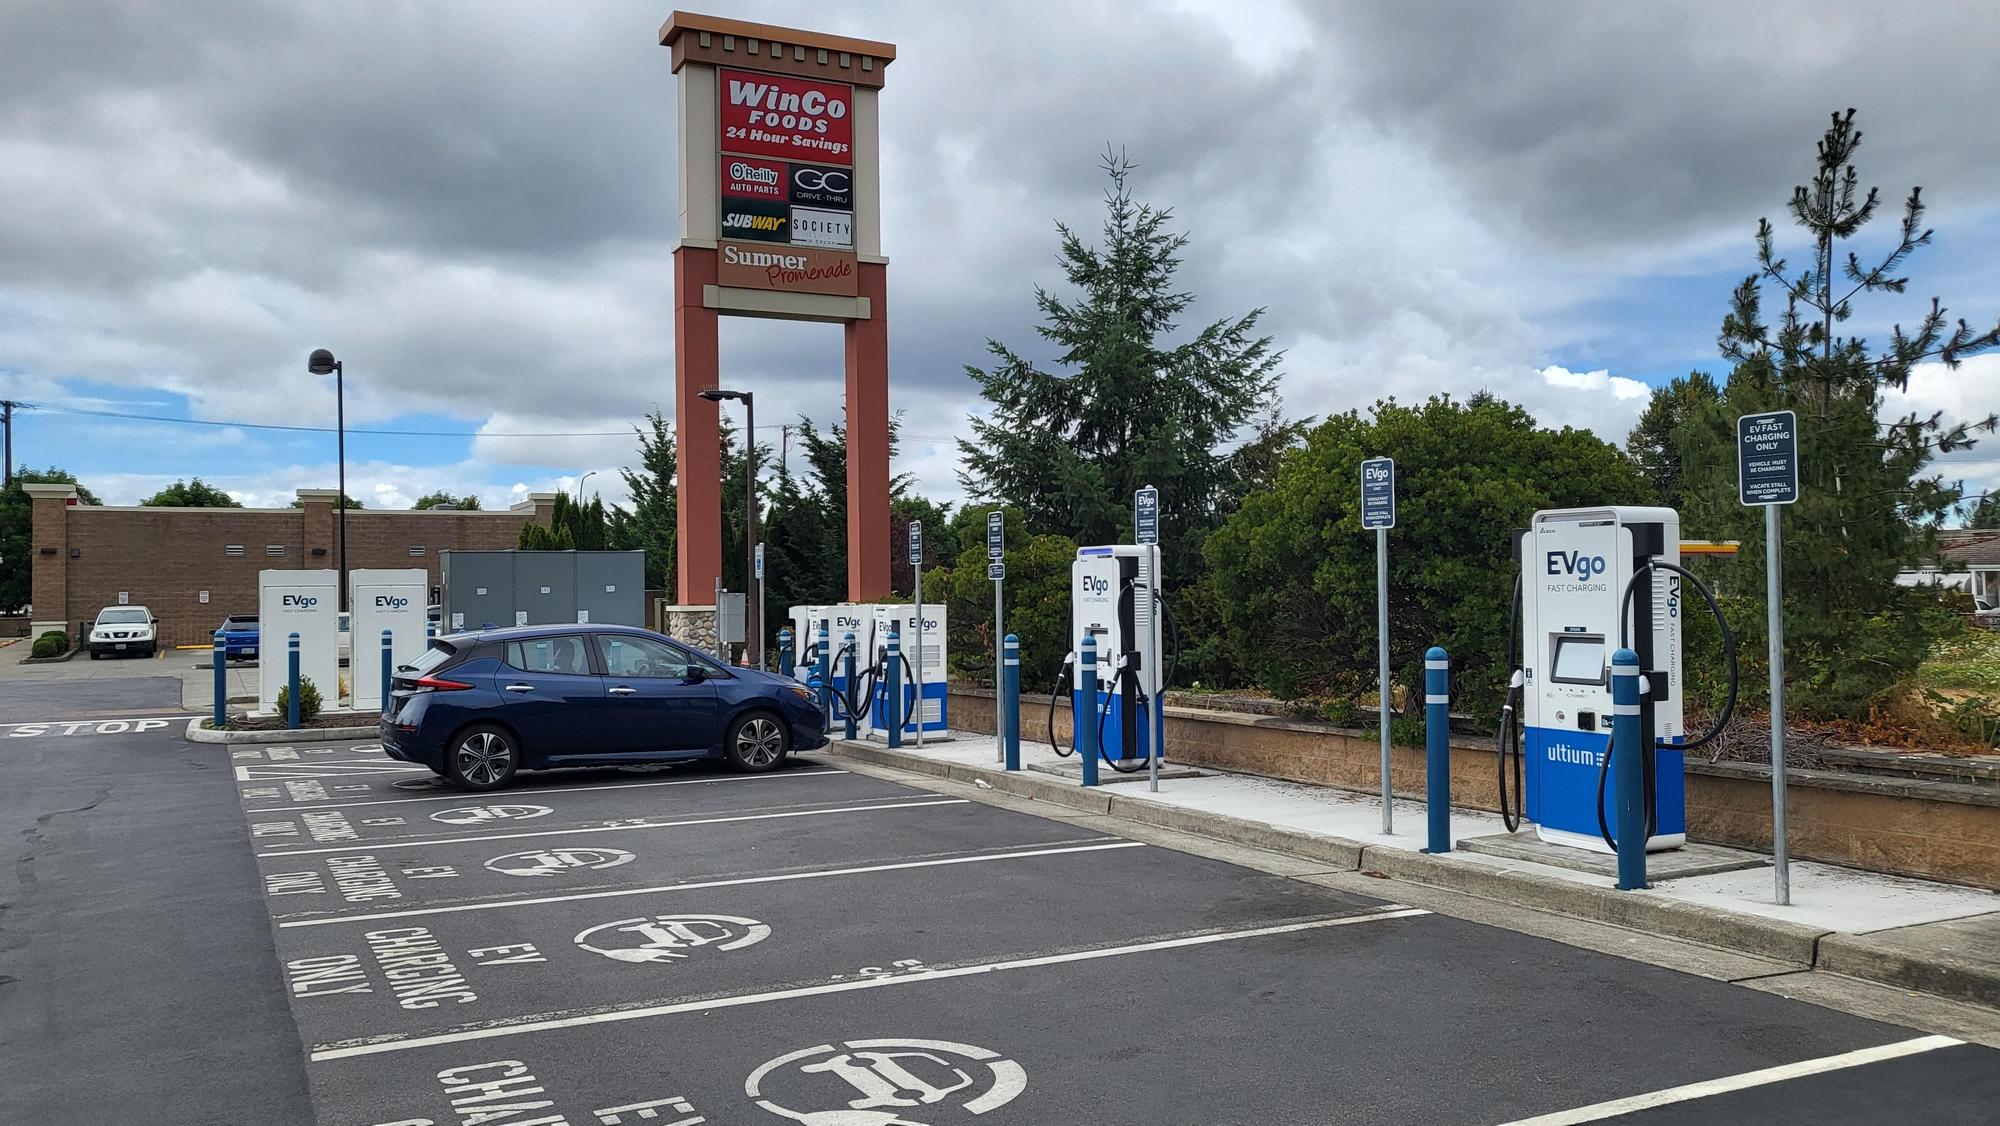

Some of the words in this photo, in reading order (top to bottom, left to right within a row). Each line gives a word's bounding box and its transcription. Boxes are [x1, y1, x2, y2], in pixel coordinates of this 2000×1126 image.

[729, 80, 846, 118] WinCo
[749, 110, 829, 133] FOODS
[726, 126, 746, 139] 24
[749, 129, 789, 144] Hour
[792, 135, 848, 154] Savings
[730, 162, 778, 185] O'Reilly
[794, 168, 848, 193] GC
[730, 183, 752, 192] AUTO
[754, 186, 779, 195] PARTS
[796, 192, 848, 203] DRIVE-THRU
[722, 213, 786, 231] SUBWAY
[793, 219, 850, 235] SOCIETY
[724, 246, 808, 270] Sumner
[765, 259, 852, 286] Promenade
[1744, 431, 1790, 443] CHARGING
[1749, 425, 1761, 433] EV
[1762, 423, 1784, 432] FAST
[1756, 442, 1778, 451] ONLY
[1366, 467, 1389, 481] EVgo
[1757, 465, 1786, 473] CHARGING
[1139, 495, 1155, 507] EVgo
[1547, 550, 1606, 581] EVgo
[1083, 575, 1109, 596] EVgo
[1547, 584, 1566, 592] FAST
[1566, 583, 1607, 592] CHARGING
[282, 595, 318, 609] EVgo
[375, 596, 408, 609] EVgo
[1667, 575, 1679, 618] EVgo
[9, 720, 170, 738] STOP
[1547, 743, 1594, 766] ultium
[325, 855, 402, 902] CHARGING
[400, 865, 460, 879] EV
[264, 871, 327, 896] ONLY
[467, 942, 547, 966] EV
[286, 954, 373, 998] ONLY
[364, 926, 478, 1010] CHARGING
